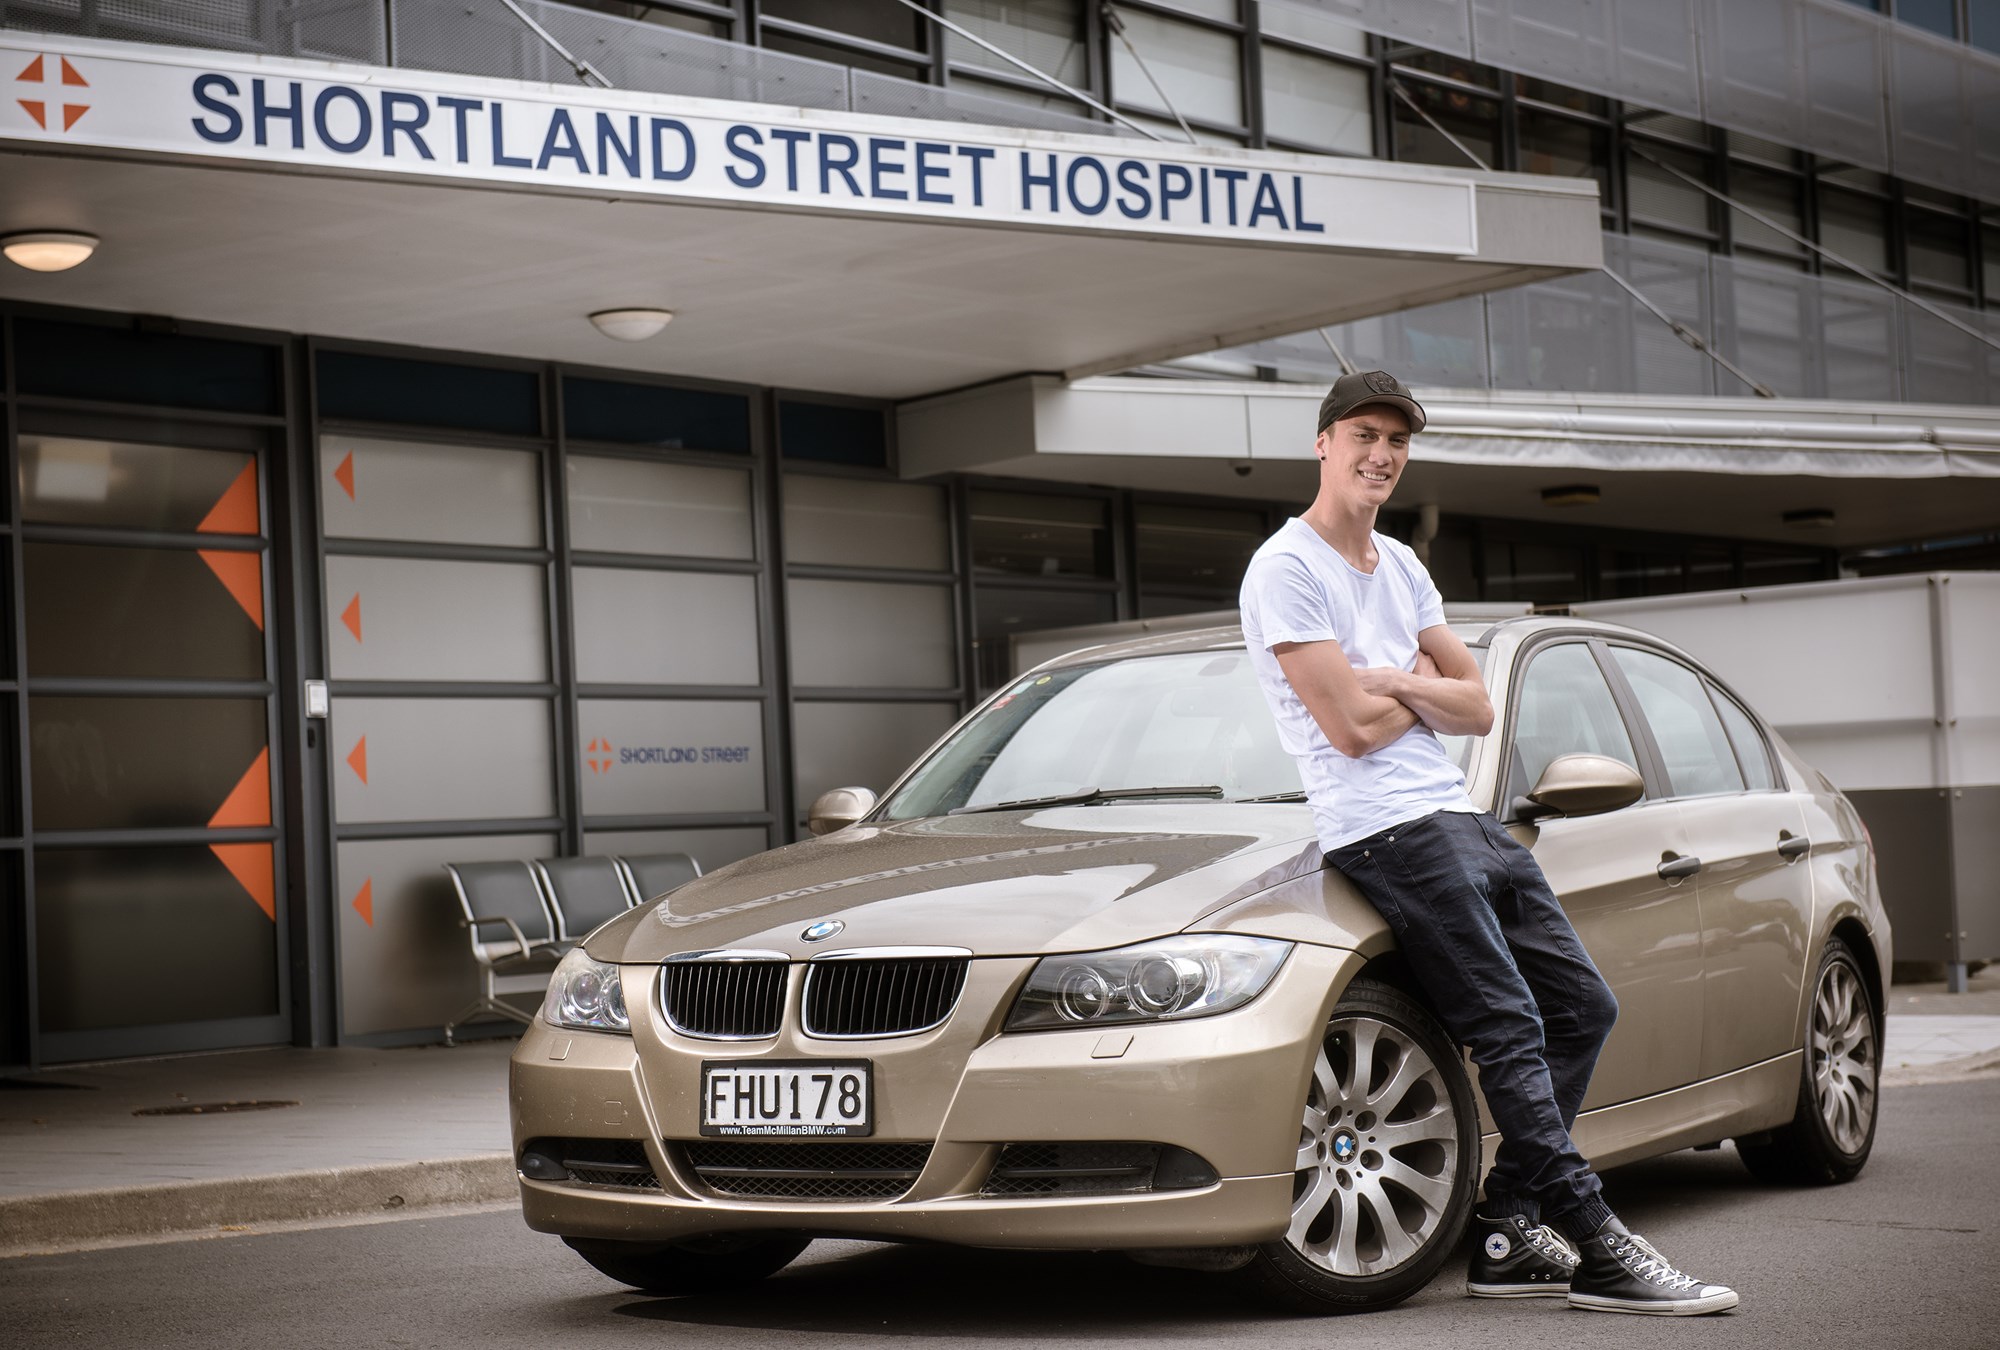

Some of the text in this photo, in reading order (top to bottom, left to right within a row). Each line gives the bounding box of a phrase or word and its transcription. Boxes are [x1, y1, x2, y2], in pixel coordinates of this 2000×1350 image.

[192, 73, 1325, 233] SHORTLAND STREET HOSPITAL
[711, 1074, 861, 1119] FHU178
[720, 1125, 846, 1136] www.TeamMcMillanBMW.com
